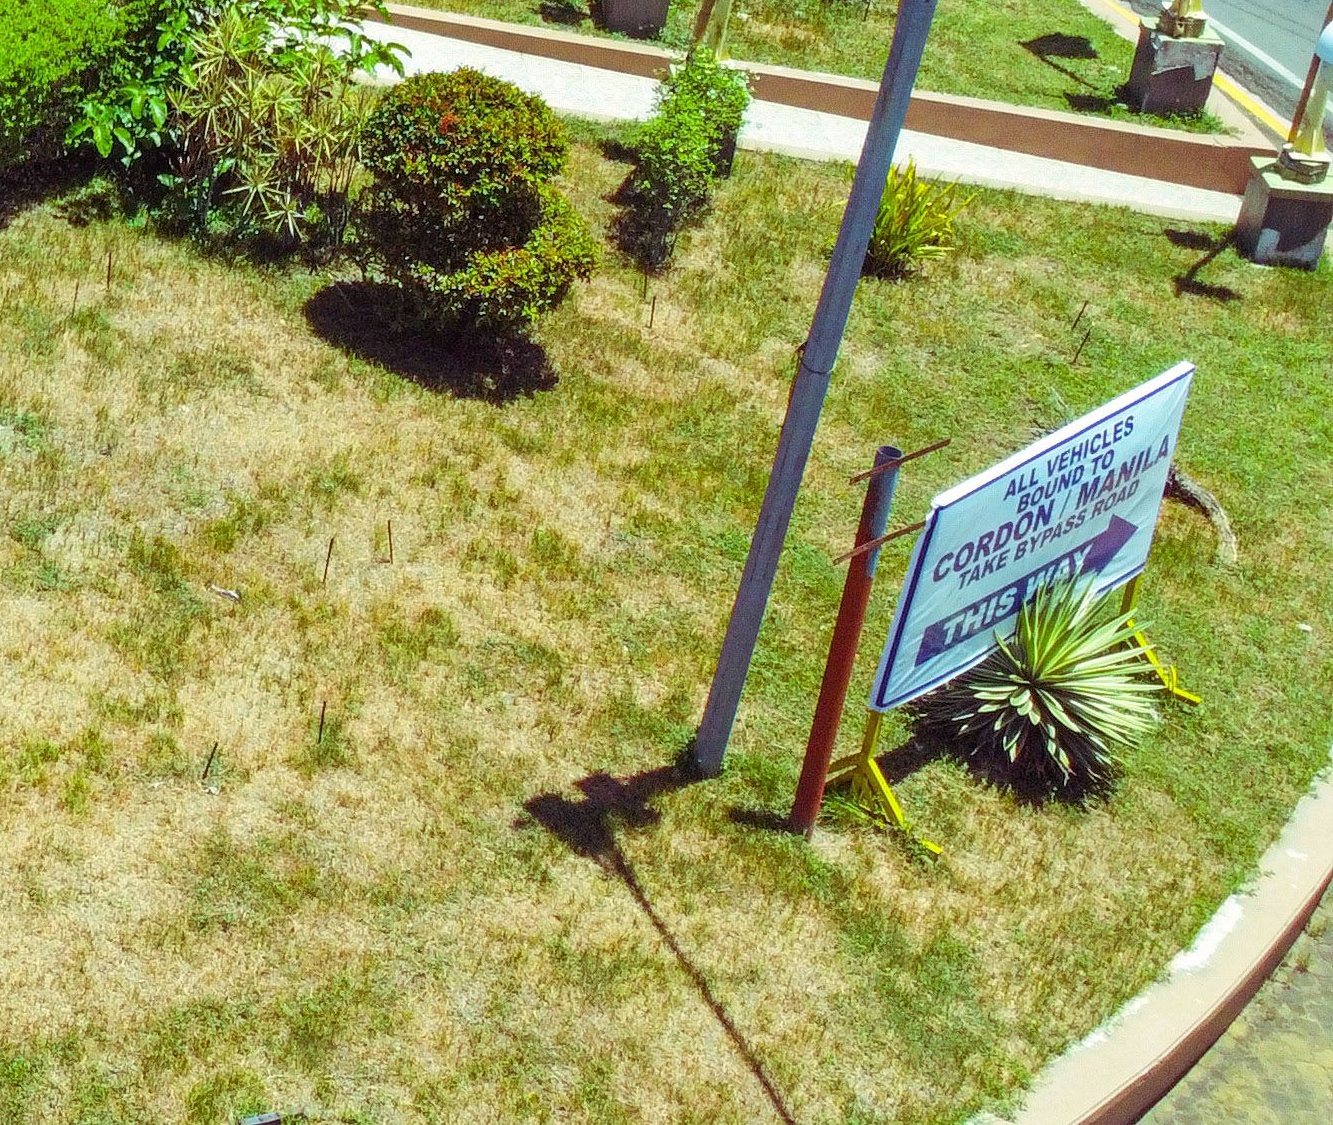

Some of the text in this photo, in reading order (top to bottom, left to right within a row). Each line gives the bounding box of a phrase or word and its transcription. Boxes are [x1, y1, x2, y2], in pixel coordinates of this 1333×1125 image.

[1002, 415, 1135, 501] ALL VEHICLES
[1016, 449, 1115, 514] BOUND TO
[933, 504, 1055, 583] CORDON
[1075, 434, 1170, 512] MANILA
[958, 479, 1141, 591] TAKE BYPASS ROAD
[943, 586, 1018, 646] THIS
